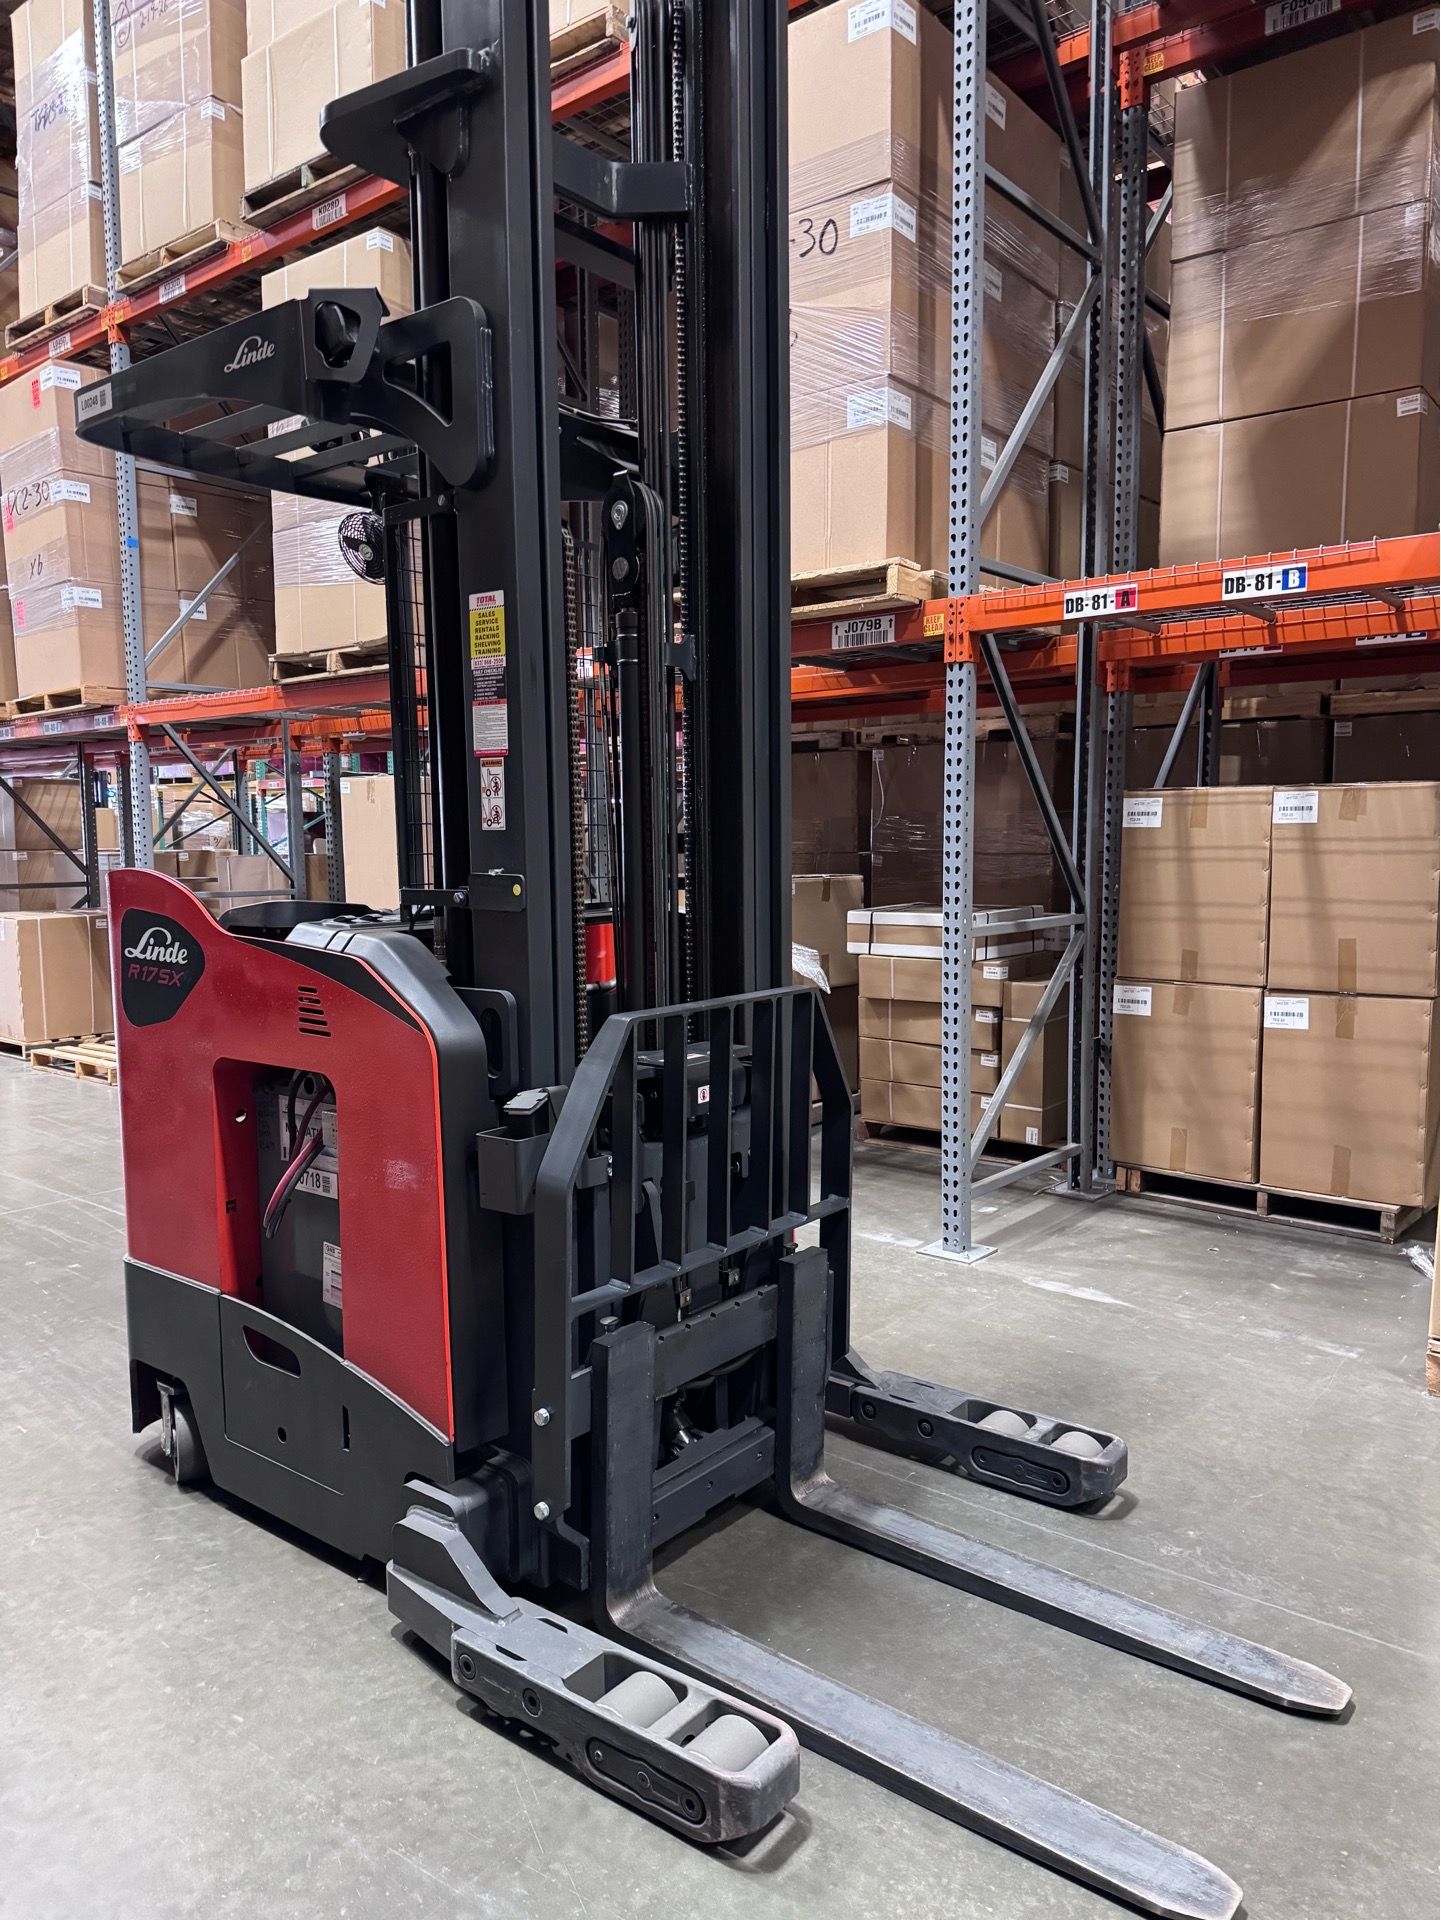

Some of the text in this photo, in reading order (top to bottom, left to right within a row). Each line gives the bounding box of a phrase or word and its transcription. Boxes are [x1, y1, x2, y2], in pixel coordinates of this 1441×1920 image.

[224, 335, 275, 373] Linde
[1224, 569, 1300, 595] DB-81-B
[476, 595, 496, 604] TOTAL
[1065, 590, 1131, 614] DB-81-A
[475, 618, 498, 626] SERVICE
[925, 615, 941, 625] KEEP
[475, 625, 499, 634] RENTALS
[844, 618, 882, 634] J079B
[924, 622, 943, 633] CLEAR
[475, 633, 500, 641] RACKING
[474, 640, 501, 648] SHELVING
[475, 648, 501, 656] TRAINING
[124, 926, 188, 964] Linde
